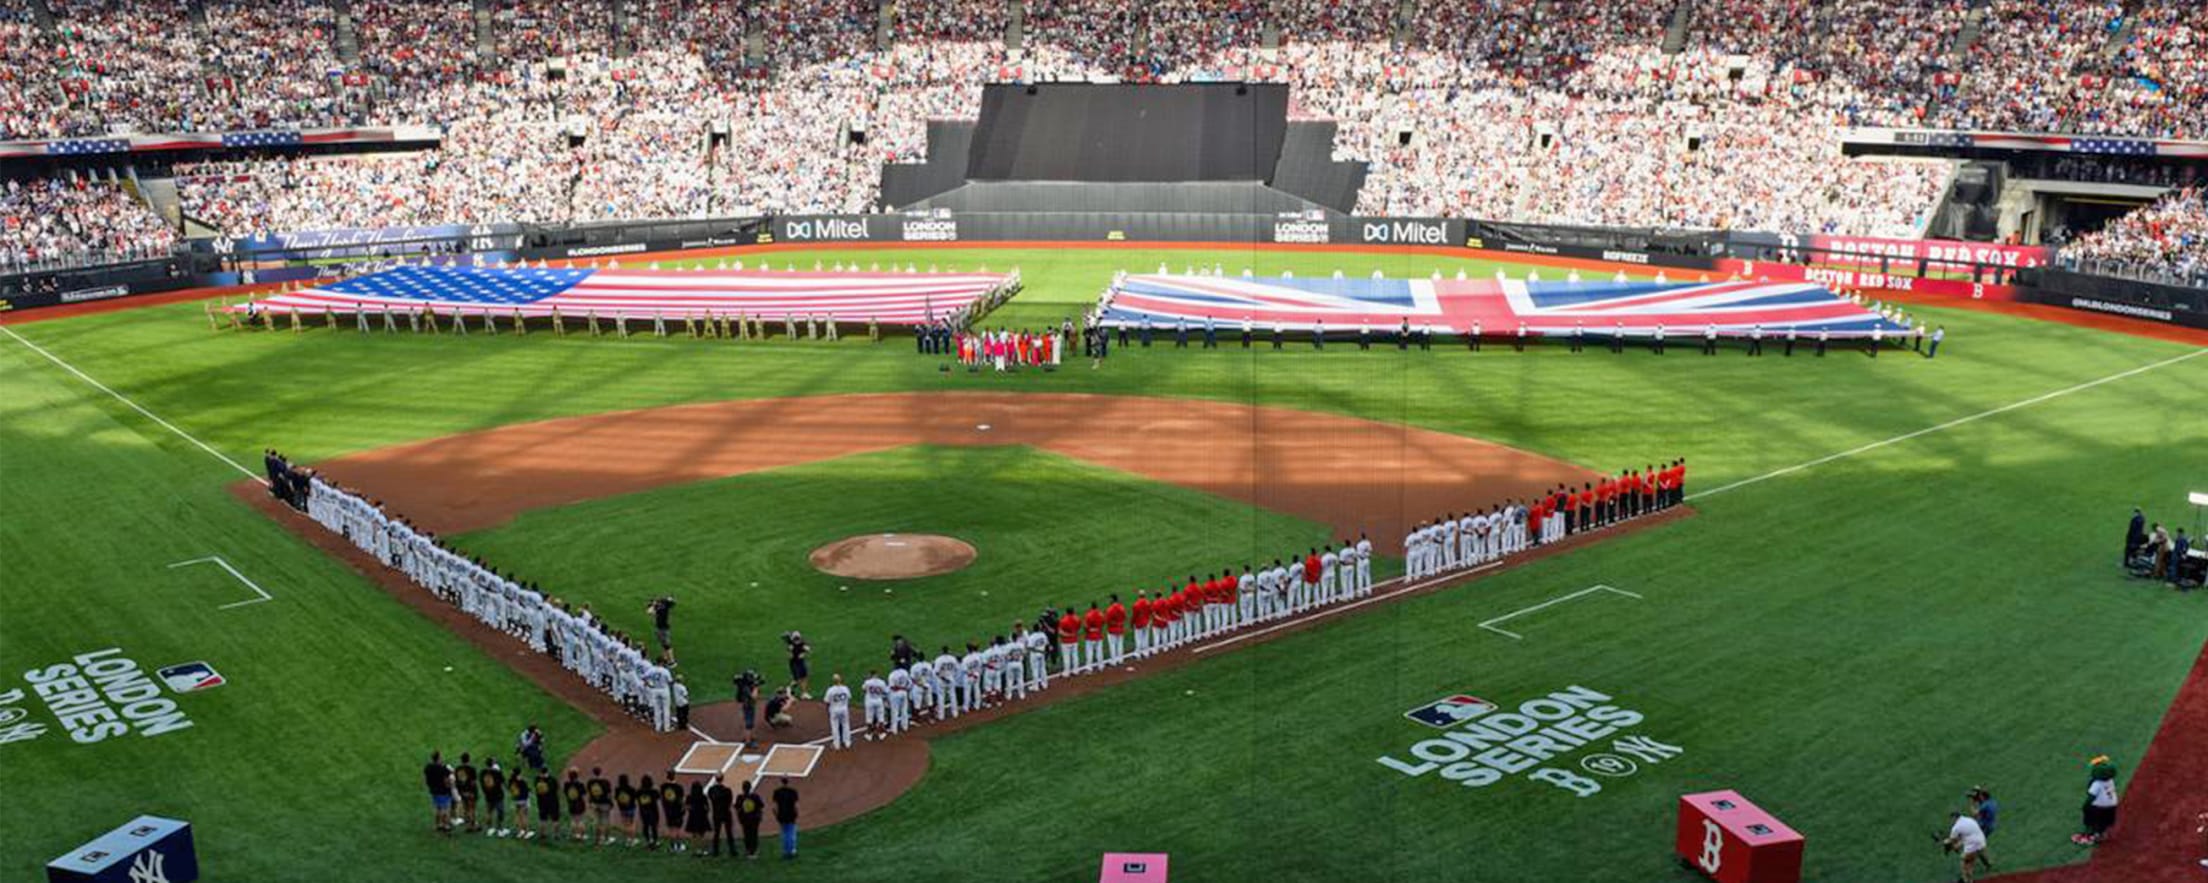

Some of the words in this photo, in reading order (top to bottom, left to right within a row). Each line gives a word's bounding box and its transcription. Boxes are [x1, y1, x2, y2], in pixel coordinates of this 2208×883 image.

[815, 217, 870, 241] Mitel
[903, 221, 956, 231] LONDON
[1275, 223, 1329, 232] LONDON
[1393, 221, 1448, 243] Mitel
[1829, 240, 1916, 264] BOSTON
[1928, 245, 1971, 268] RED
[1859, 273, 1884, 288] RED
[1887, 276, 1913, 290] SOX
[24, 663, 128, 743] SERIES
[73, 647, 194, 737] LONDON
[1376, 685, 1613, 777] LONDON
[1439, 704, 1644, 787] SERIES
[1698, 819, 1723, 874] B
